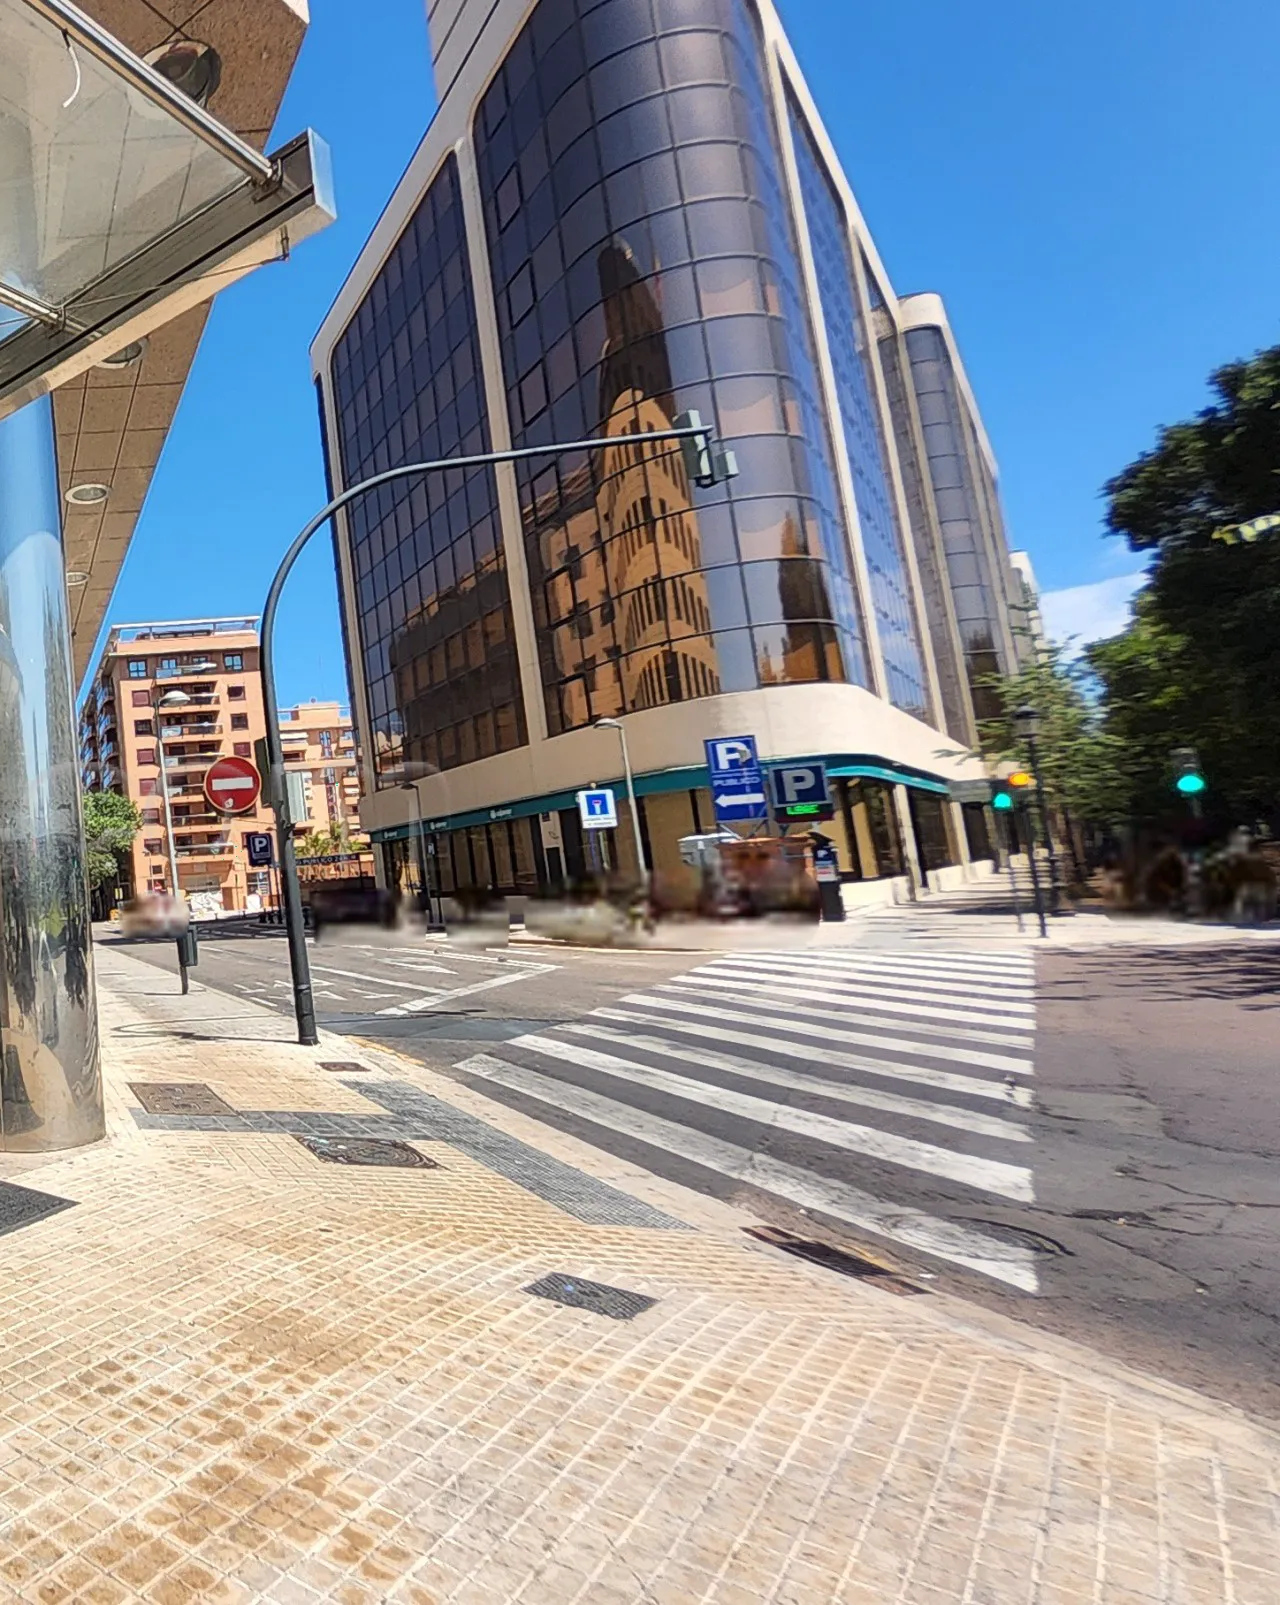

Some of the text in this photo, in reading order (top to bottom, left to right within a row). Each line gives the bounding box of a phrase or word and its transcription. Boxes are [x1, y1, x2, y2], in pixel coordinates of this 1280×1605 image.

[715, 741, 753, 770] P
[781, 768, 816, 802] P
[254, 837, 268, 852] P
